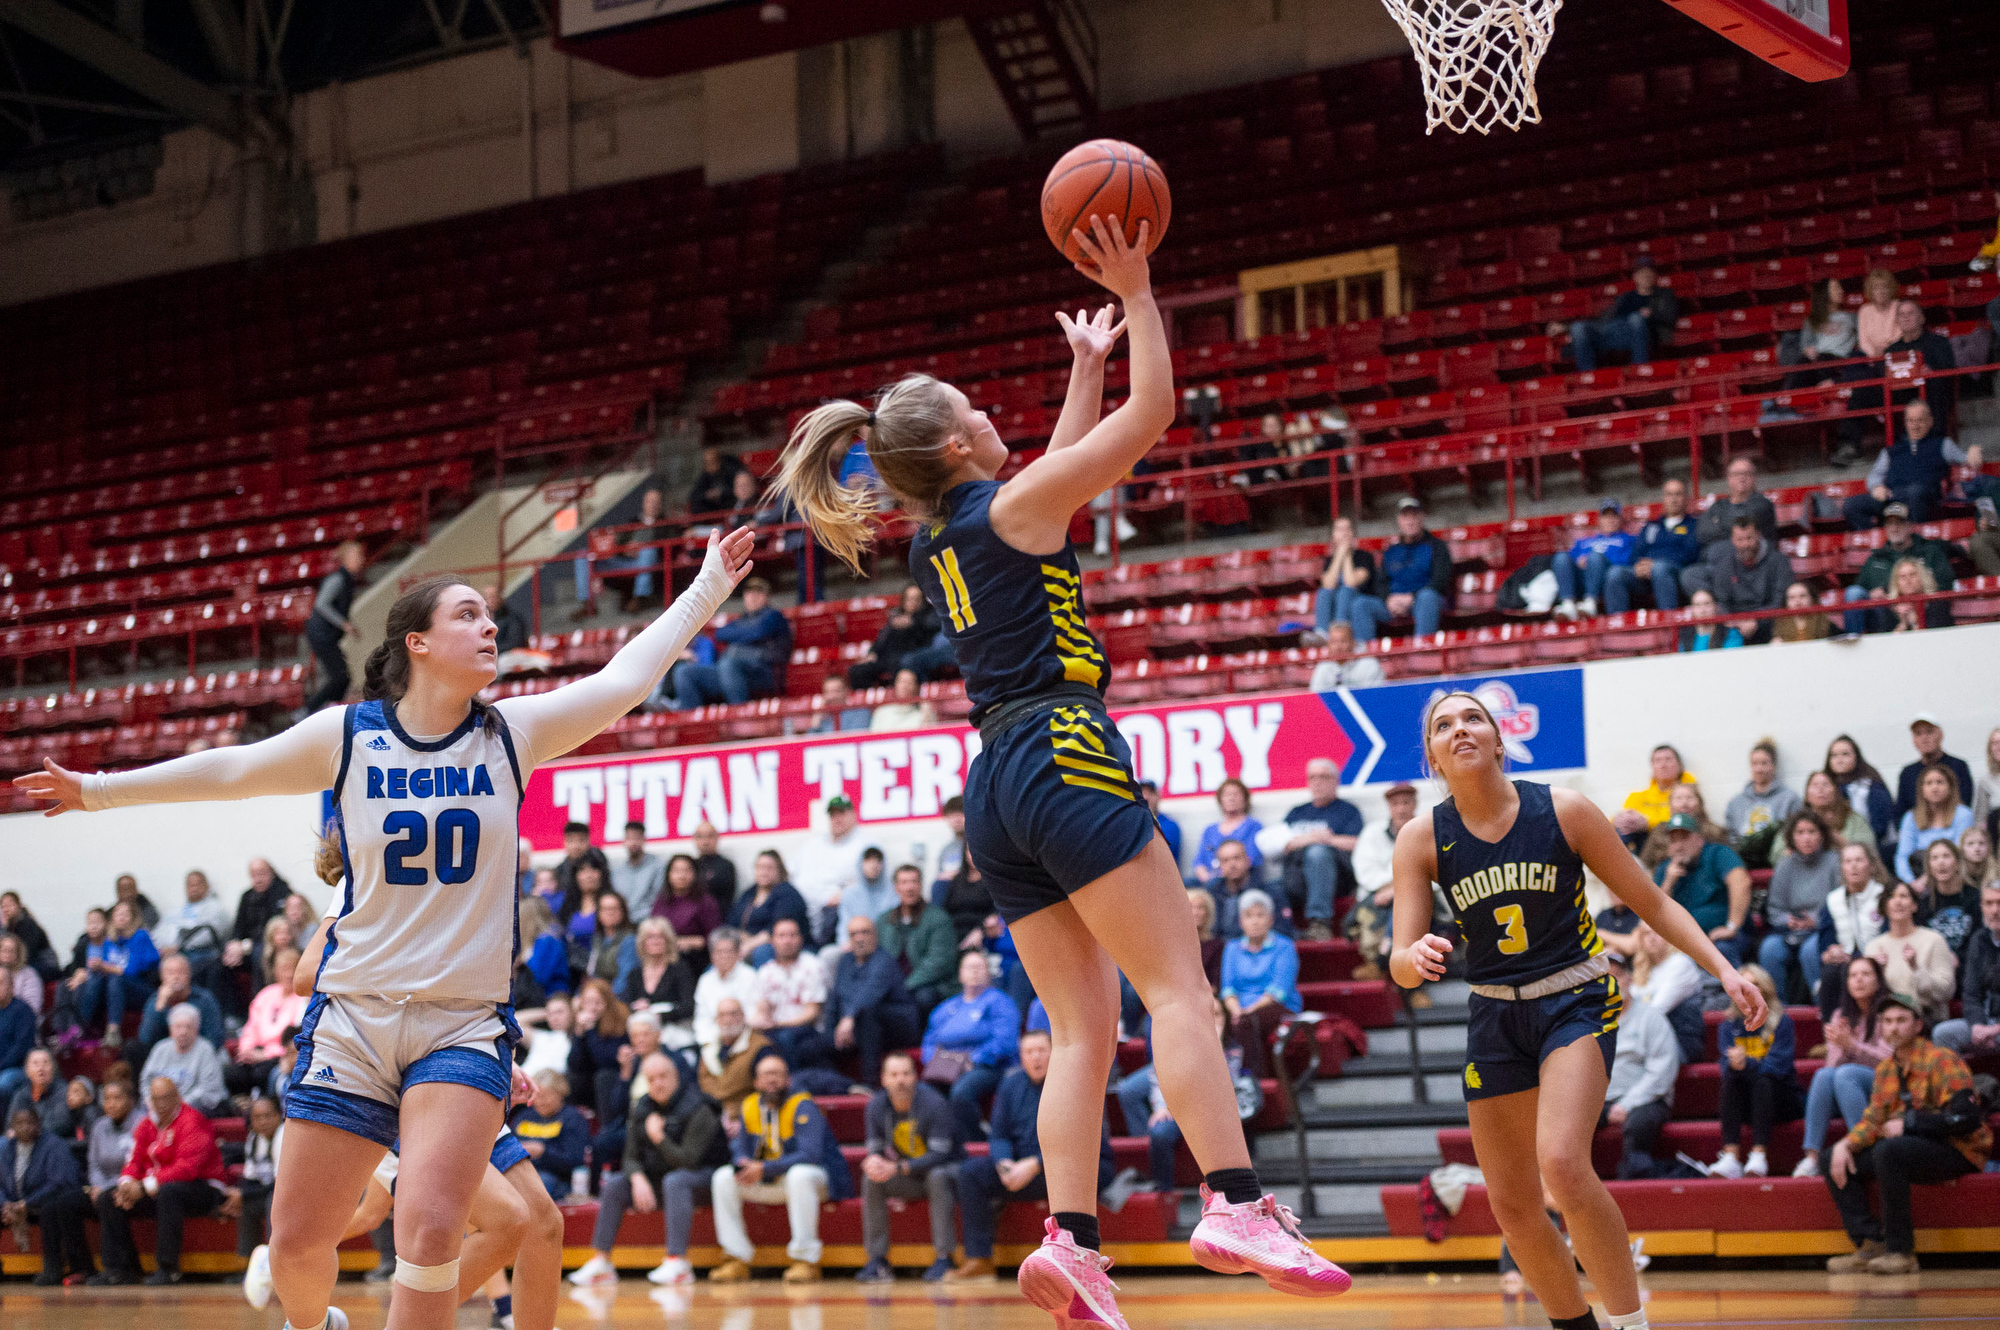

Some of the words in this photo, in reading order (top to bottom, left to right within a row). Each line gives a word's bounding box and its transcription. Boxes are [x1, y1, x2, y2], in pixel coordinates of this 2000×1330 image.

[929, 546, 977, 633] 11
[366, 763, 495, 799] REGINA
[553, 750, 780, 842] TITAN
[803, 702, 1284, 821] TERORY
[382, 807, 480, 886] 20
[1451, 862, 1557, 911] GOODRICH
[1493, 904, 1529, 955] 3
